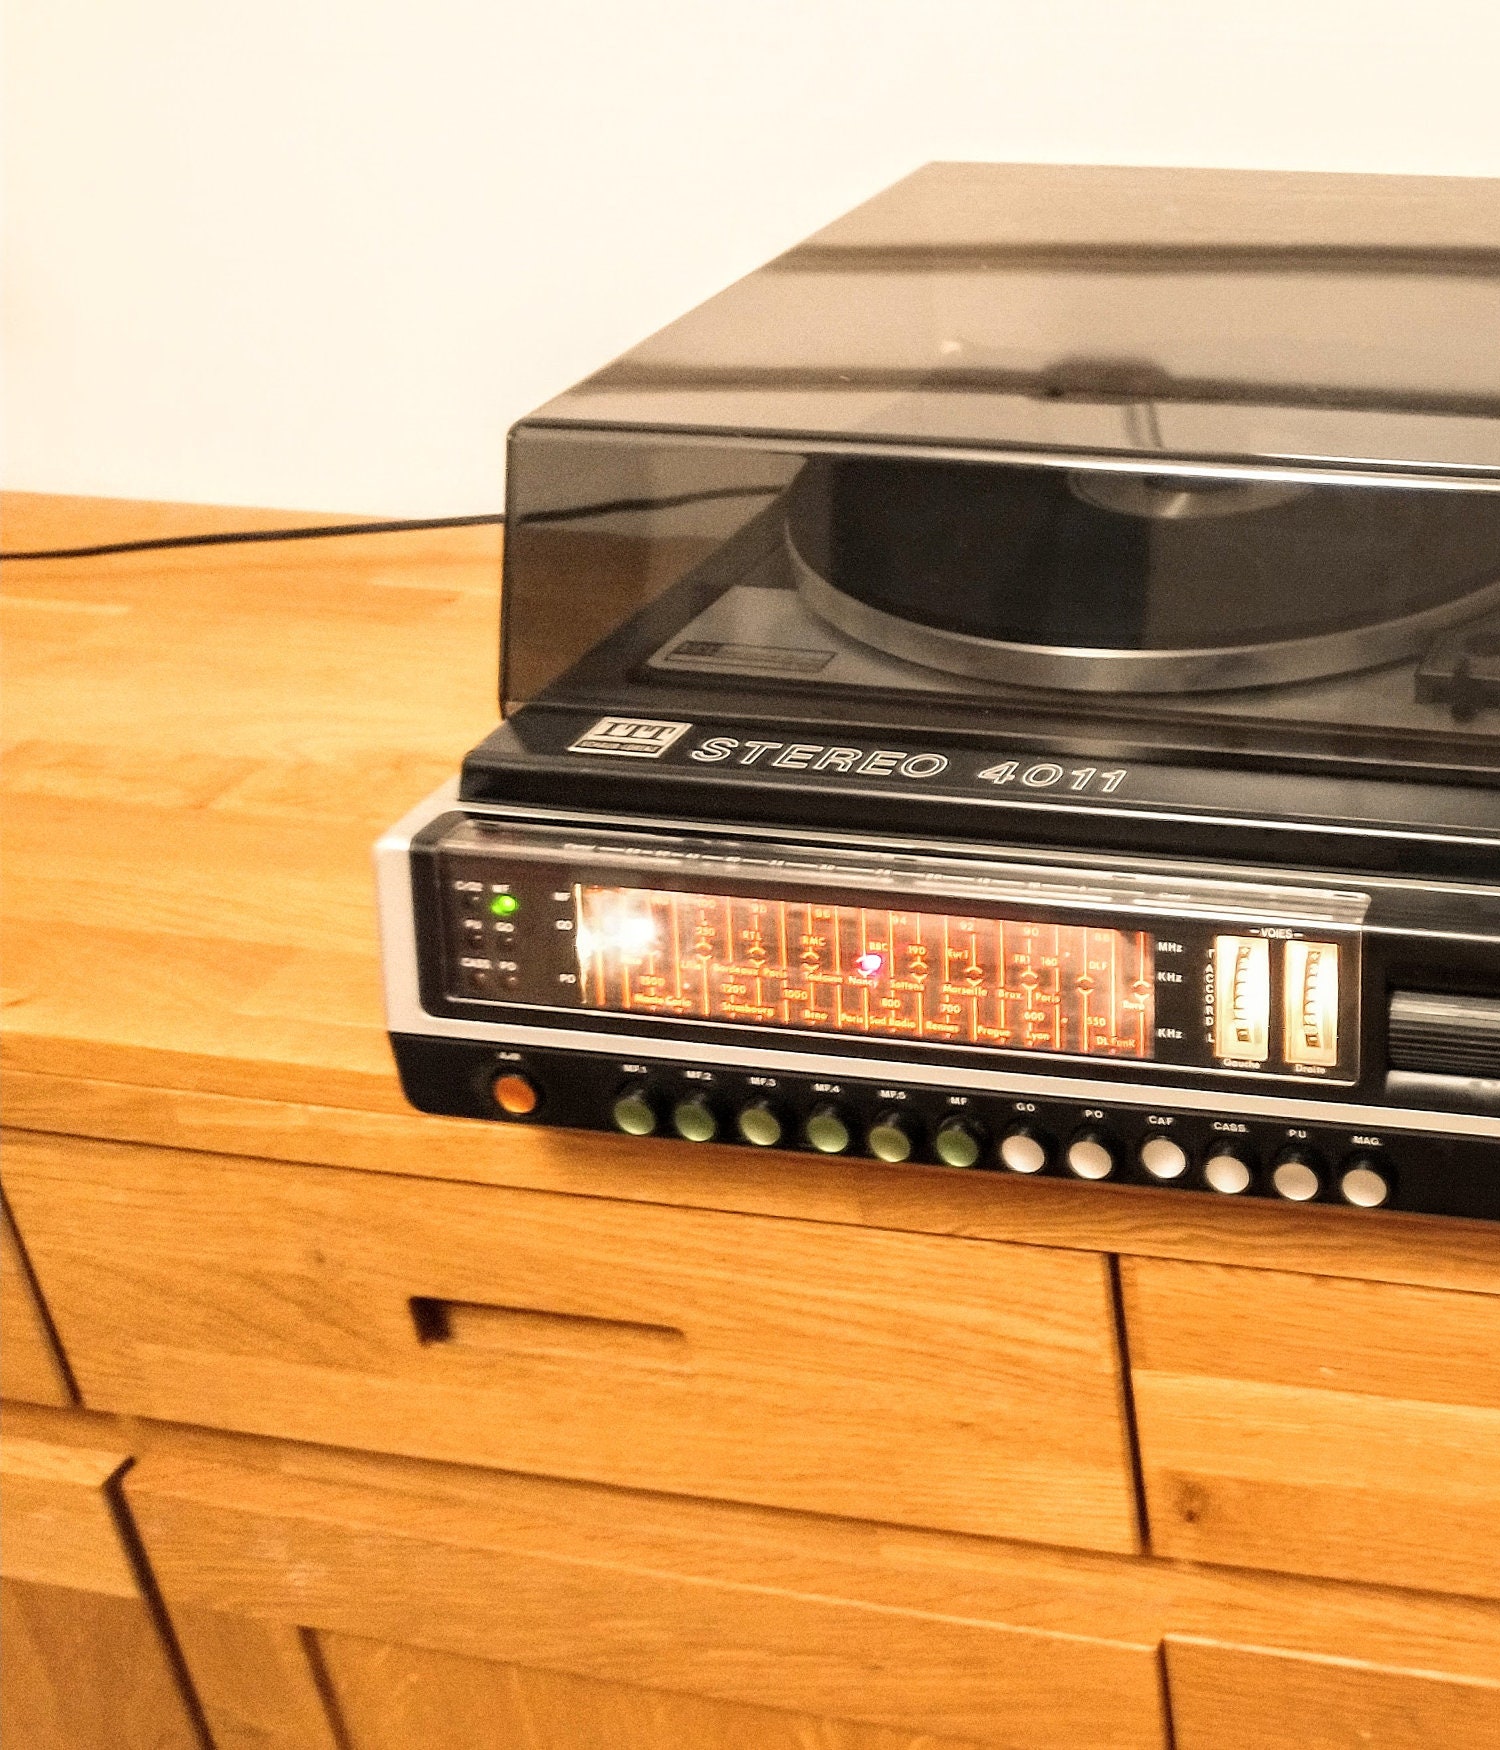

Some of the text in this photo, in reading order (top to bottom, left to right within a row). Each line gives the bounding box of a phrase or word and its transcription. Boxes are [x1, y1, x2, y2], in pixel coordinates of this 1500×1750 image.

[691, 737, 1128, 794] STEREO 4011
[891, 916, 907, 925] 94
[960, 921, 974, 931] 92
[1024, 928, 1039, 937] 90
[1158, 941, 1183, 953] MHz
[1260, 928, 1293, 939] VOIES
[742, 930, 763, 941] RTL
[801, 935, 826, 947] RMC
[869, 941, 888, 951] BBC
[908, 945, 926, 955] 190
[1041, 956, 1058, 966] 160
[1089, 961, 1108, 970] DLF
[1158, 972, 1183, 983] KHz
[848, 975, 879, 988] Nancy
[1035, 992, 1061, 1003] Paris
[721, 983, 747, 994] 1200
[783, 988, 808, 1000] 1000
[940, 1003, 961, 1014] 700
[1024, 1011, 1045, 1021] 600
[1087, 1016, 1107, 1026] 550
[1158, 1028, 1183, 1039] KHz
[1026, 1031, 1050, 1041] Lyon
[950, 1096, 967, 1105] MF
[1016, 1102, 1035, 1112] GO
[1084, 1109, 1103, 1119] PO
[1149, 1115, 1174, 1126] CAF
[1289, 1129, 1307, 1138] PU
